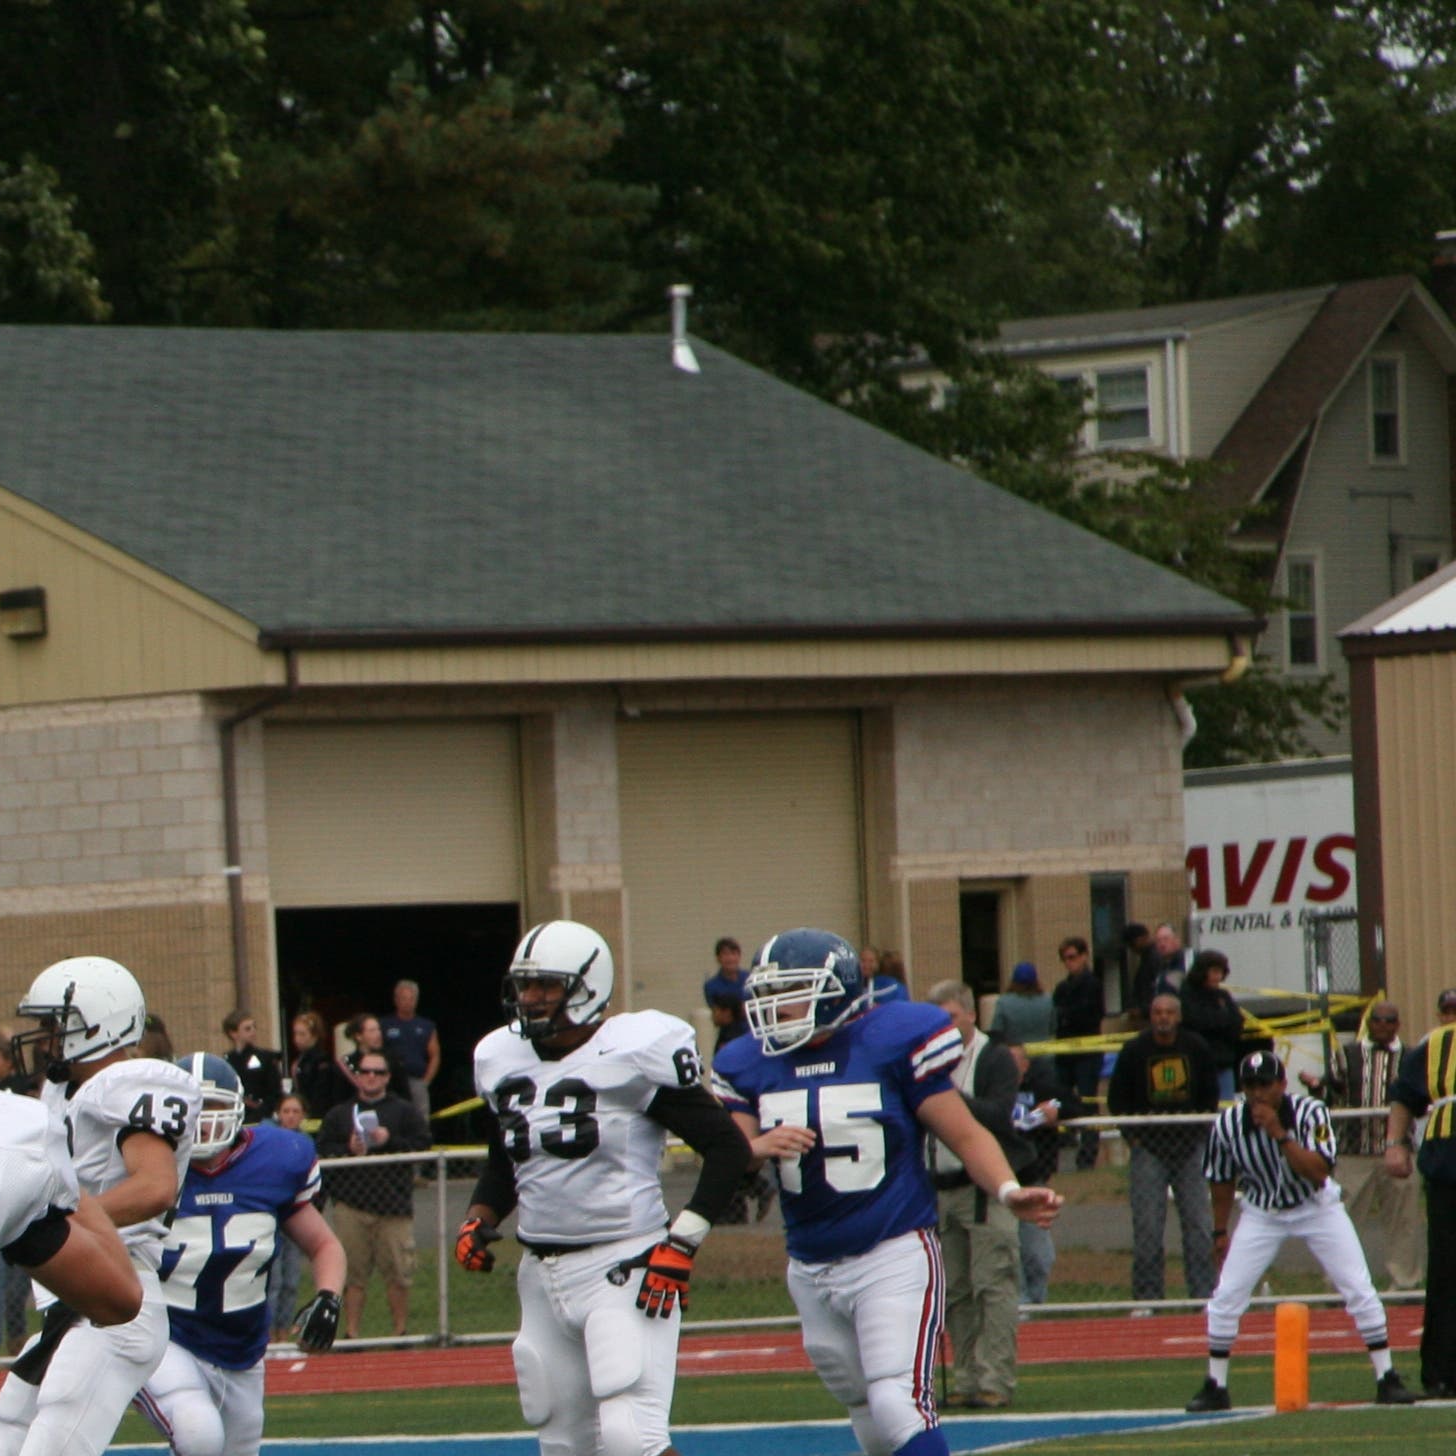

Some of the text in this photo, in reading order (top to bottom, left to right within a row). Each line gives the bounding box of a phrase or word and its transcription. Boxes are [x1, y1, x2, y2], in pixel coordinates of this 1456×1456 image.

[1185, 833, 1357, 910] AVIS
[1209, 913, 1273, 934] RENTAL
[1280, 911, 1292, 927] &
[671, 1047, 705, 1086] 6
[794, 1061, 836, 1078] WESTFIELD
[128, 1093, 188, 1136] 43
[495, 1075, 600, 1162] 63
[758, 1082, 886, 1194] 75
[195, 1192, 234, 1206] WESTFIELD
[160, 1212, 277, 1313] 72
